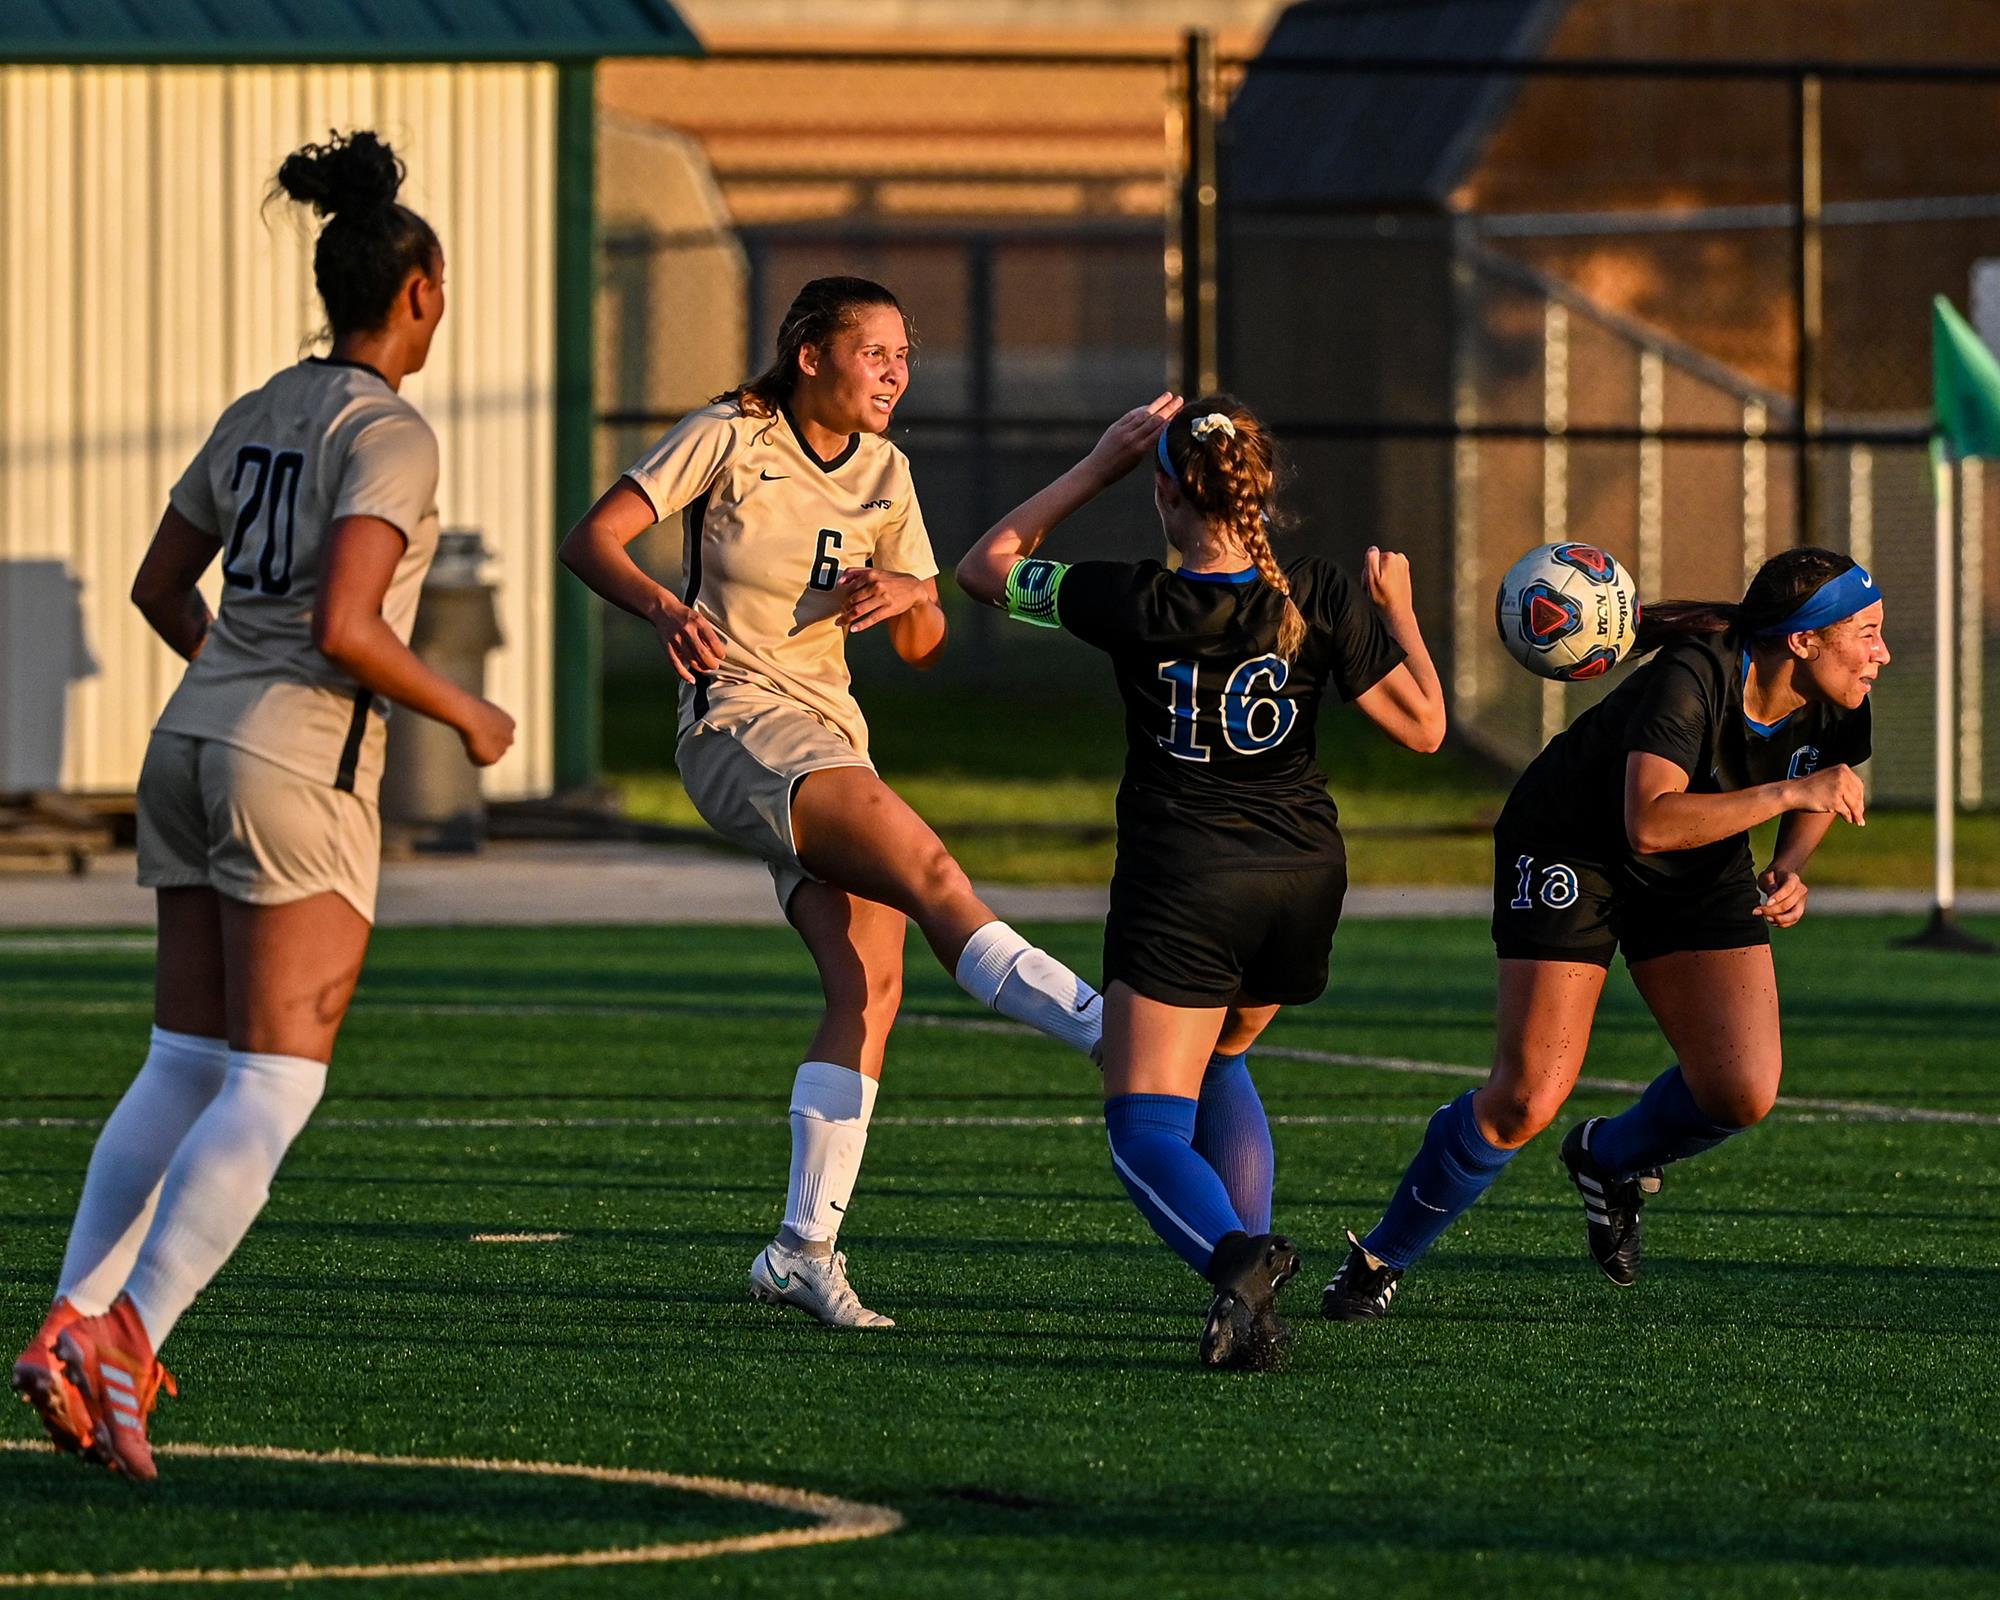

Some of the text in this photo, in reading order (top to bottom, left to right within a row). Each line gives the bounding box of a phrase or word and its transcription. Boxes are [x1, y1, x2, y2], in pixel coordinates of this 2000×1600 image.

[222, 445, 304, 595] 20
[860, 499, 894, 510] WVS
[809, 528, 843, 592] 6
[1595, 593, 1608, 636] NCAA
[1616, 590, 1629, 640] Wilson
[1156, 653, 1299, 763] 16
